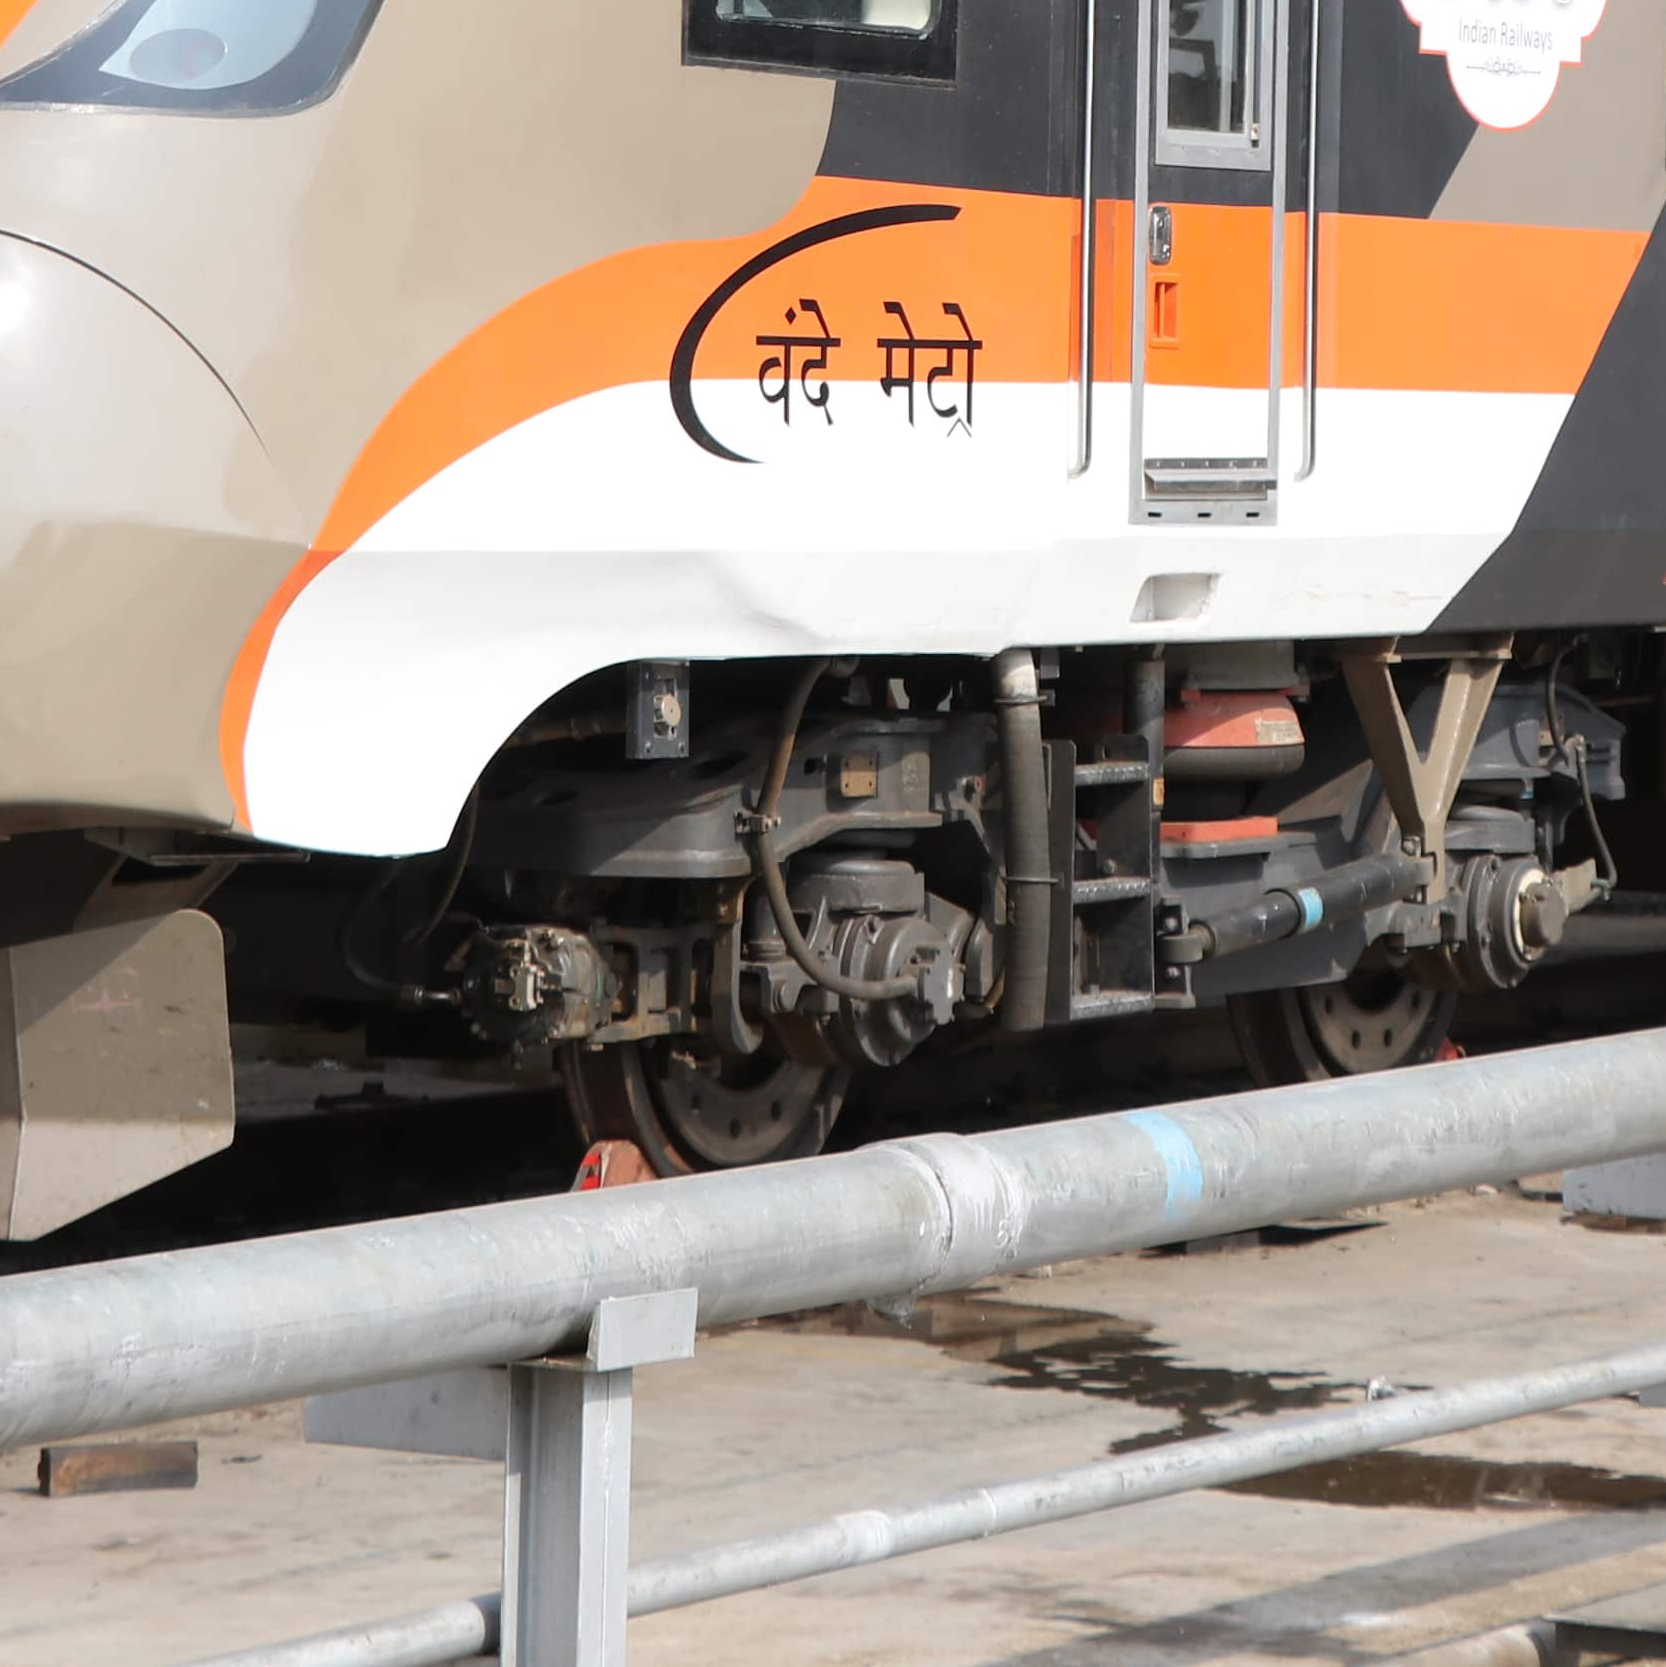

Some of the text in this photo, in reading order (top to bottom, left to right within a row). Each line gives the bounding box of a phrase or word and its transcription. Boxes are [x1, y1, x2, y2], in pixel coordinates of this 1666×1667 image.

[1458, 18, 1553, 54] Indian Railways
[756, 298, 983, 438] वंदे मेट्रो
